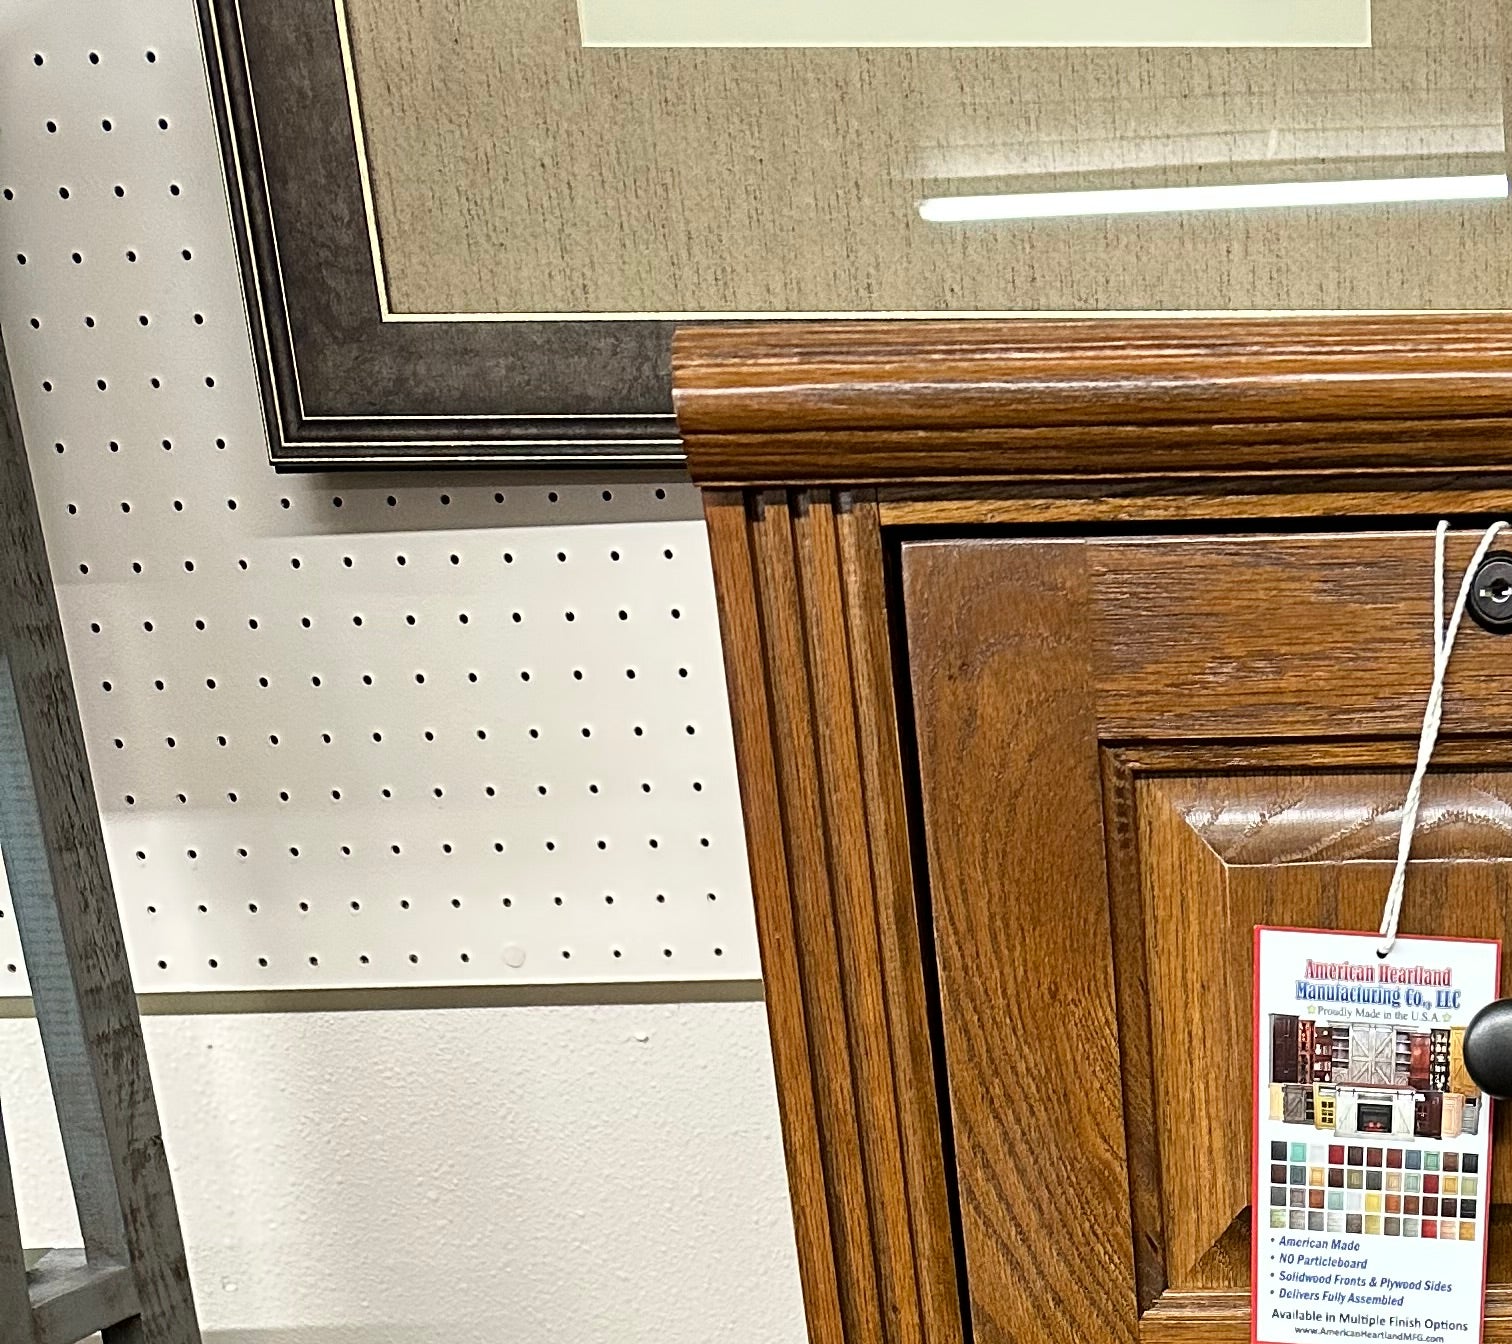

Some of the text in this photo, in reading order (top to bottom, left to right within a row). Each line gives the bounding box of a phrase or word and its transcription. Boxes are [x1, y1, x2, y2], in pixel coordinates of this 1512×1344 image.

[1304, 958, 1453, 988] American Heartland
[1295, 980, 1402, 1008] Manufacturing
[1434, 989, 1462, 1009] LLC
[1317, 1005, 1352, 1018] Proudly
[1355, 1007, 1381, 1019] Made
[1383, 1009, 1392, 1019] in
[1394, 1009, 1409, 1020] the
[1278, 1235, 1361, 1251] American Made
[1279, 1253, 1368, 1270] NO Particleboard
[1278, 1270, 1453, 1293] Solidwood Fronts & Plywood Sides
[1278, 1287, 1404, 1306] Delivers Fully Assembled
[1271, 1308, 1469, 1333] Available in Multiple Finish Options
[1294, 1326, 1445, 1343] www.AmericanHeartlandMFG.com
